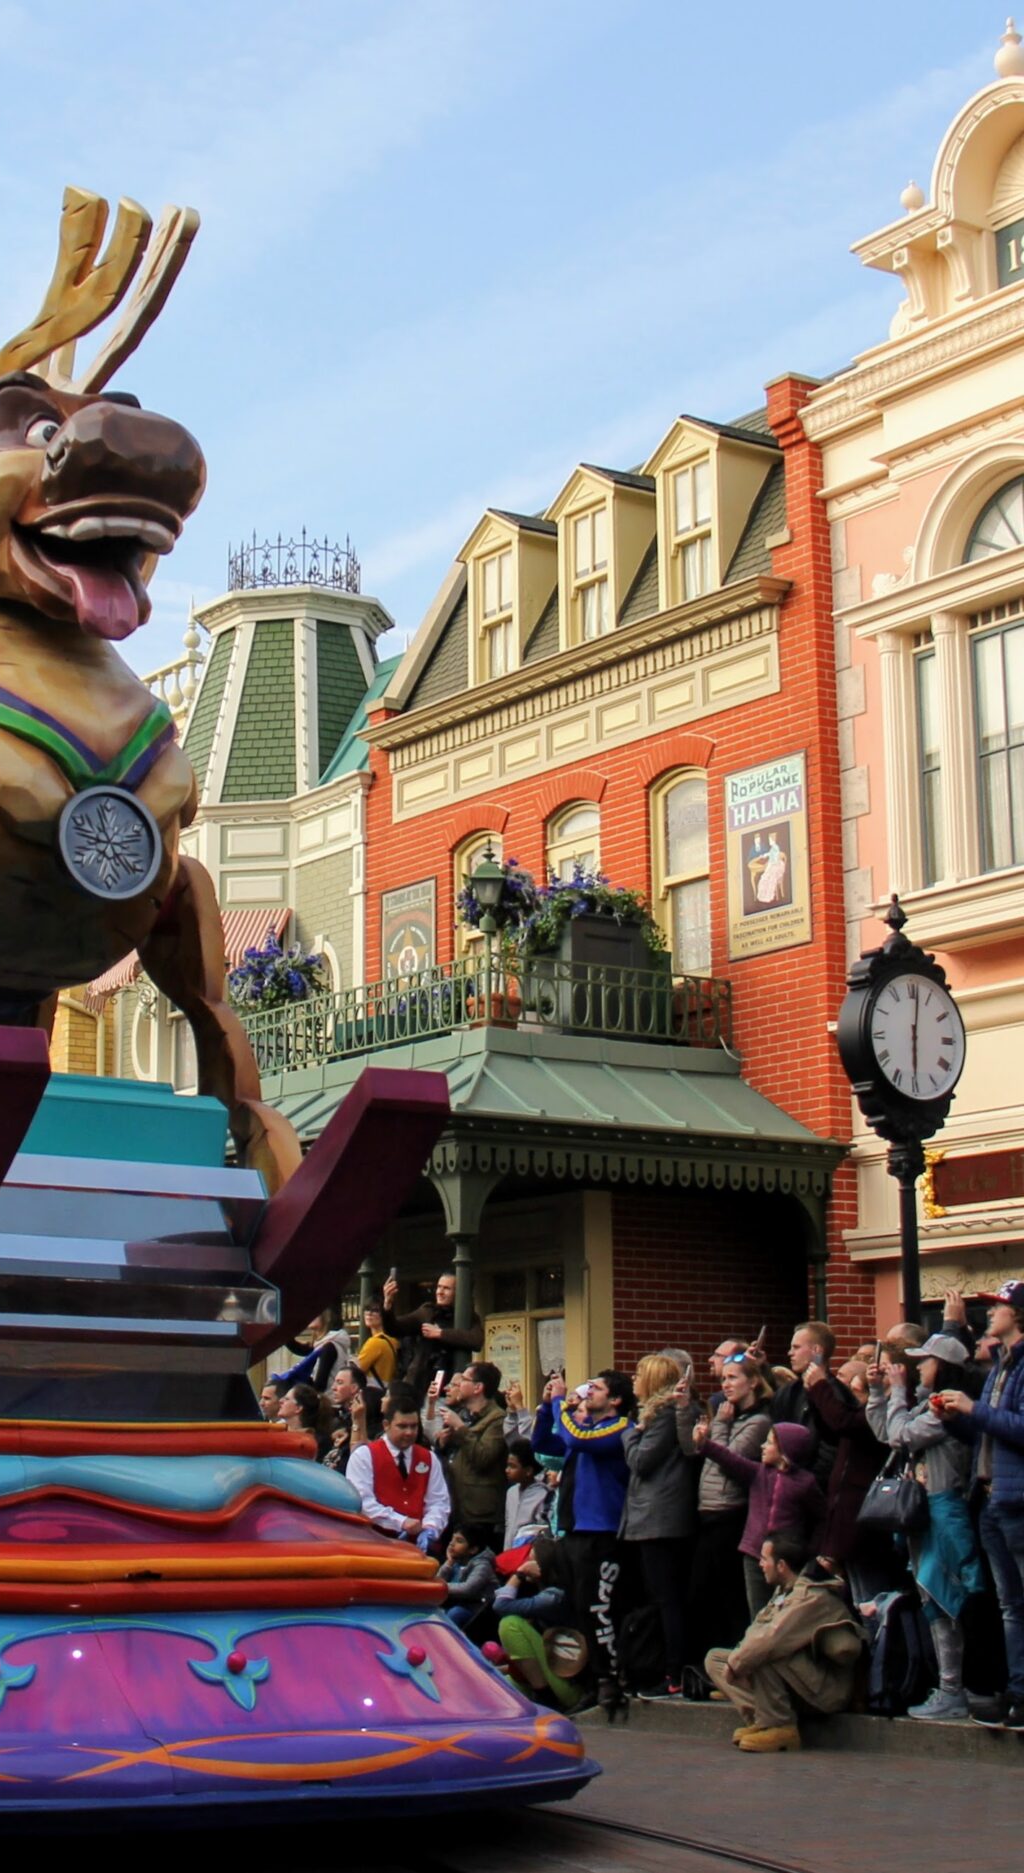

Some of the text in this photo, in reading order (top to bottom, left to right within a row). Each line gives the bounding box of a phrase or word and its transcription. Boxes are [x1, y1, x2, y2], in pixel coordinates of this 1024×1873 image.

[1007, 234, 1024, 273] 1
[731, 764, 787, 803] POPULAR
[762, 773, 800, 793] GAME
[590, 1561, 621, 1676] didas
